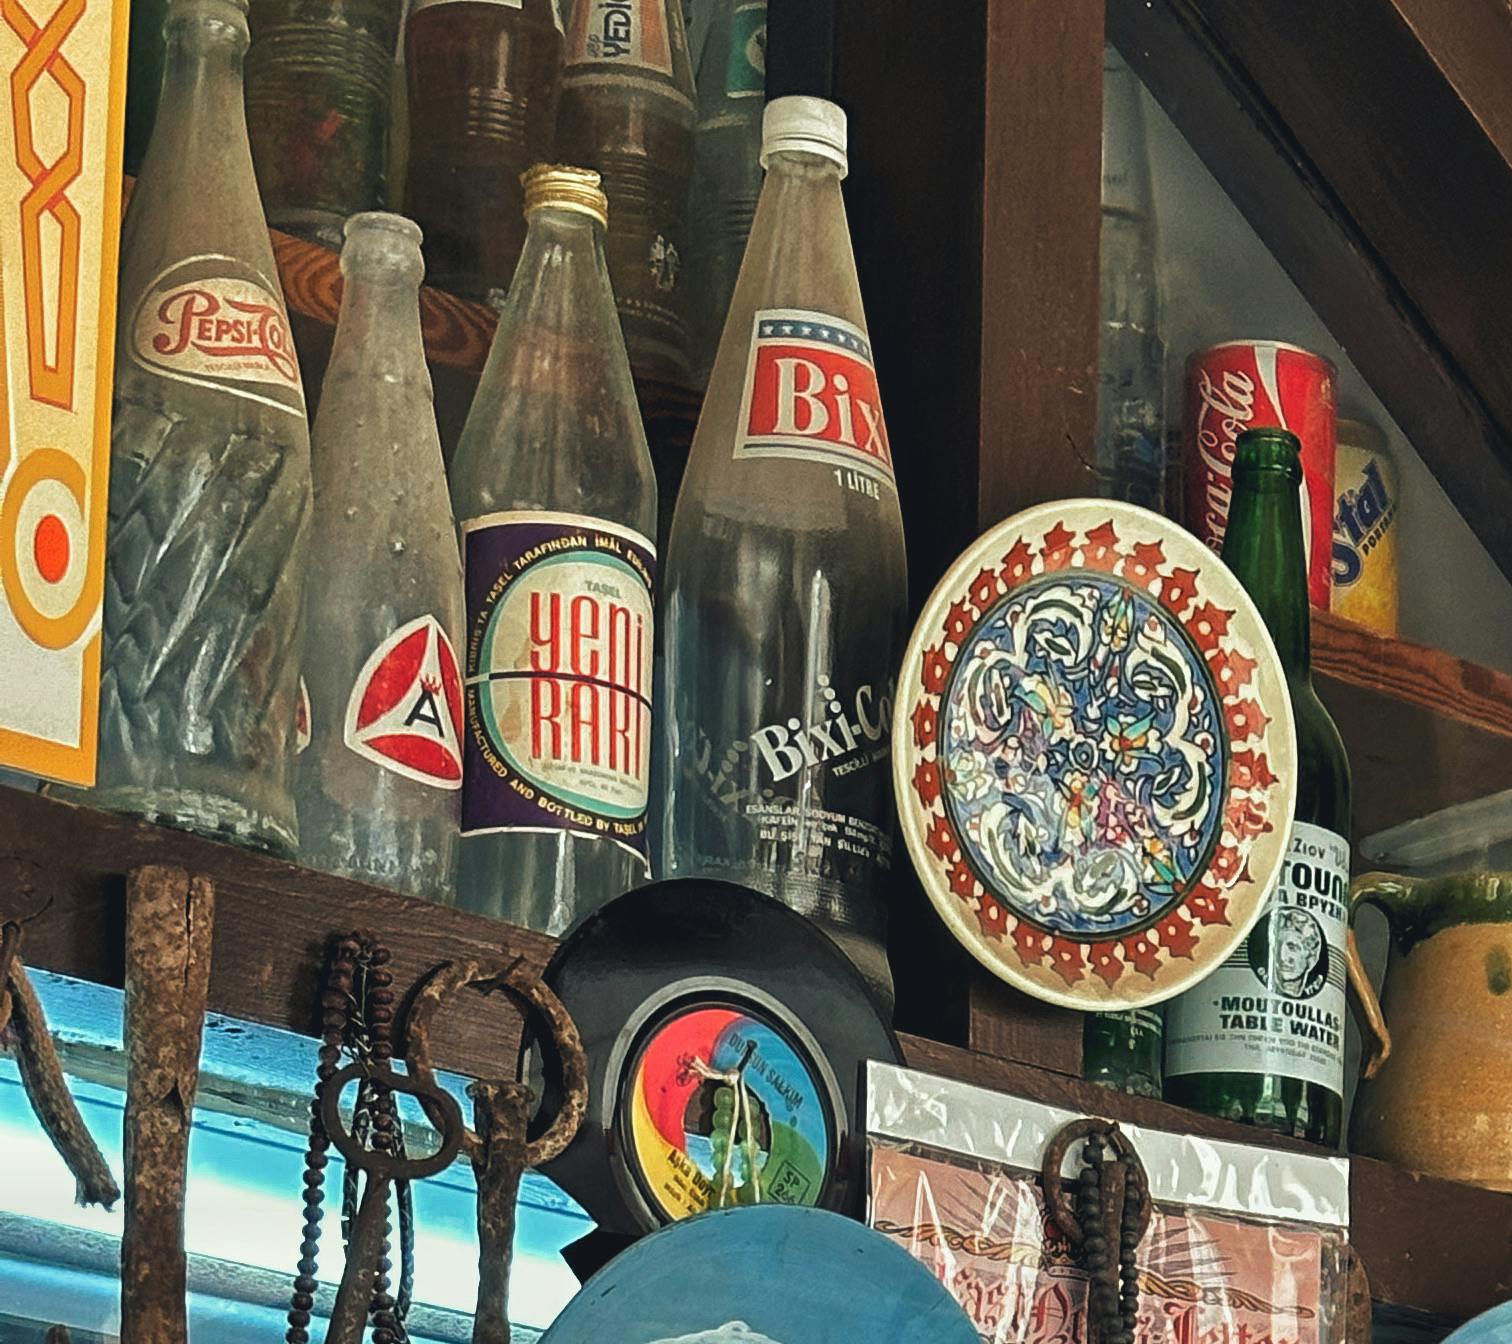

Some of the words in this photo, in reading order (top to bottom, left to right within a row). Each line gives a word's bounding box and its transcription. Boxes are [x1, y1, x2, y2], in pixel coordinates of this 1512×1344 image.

[834, 469, 843, 487] 1
[467, 689, 508, 778] MANUFACTURED
[509, 778, 535, 800] AND
[537, 796, 593, 826] BOTTLED
[596, 822, 610, 833] BY
[1219, 1014, 1283, 1034] TABLE
[1290, 1020, 1340, 1050] WATER
[783, 1171, 800, 1187] SP
